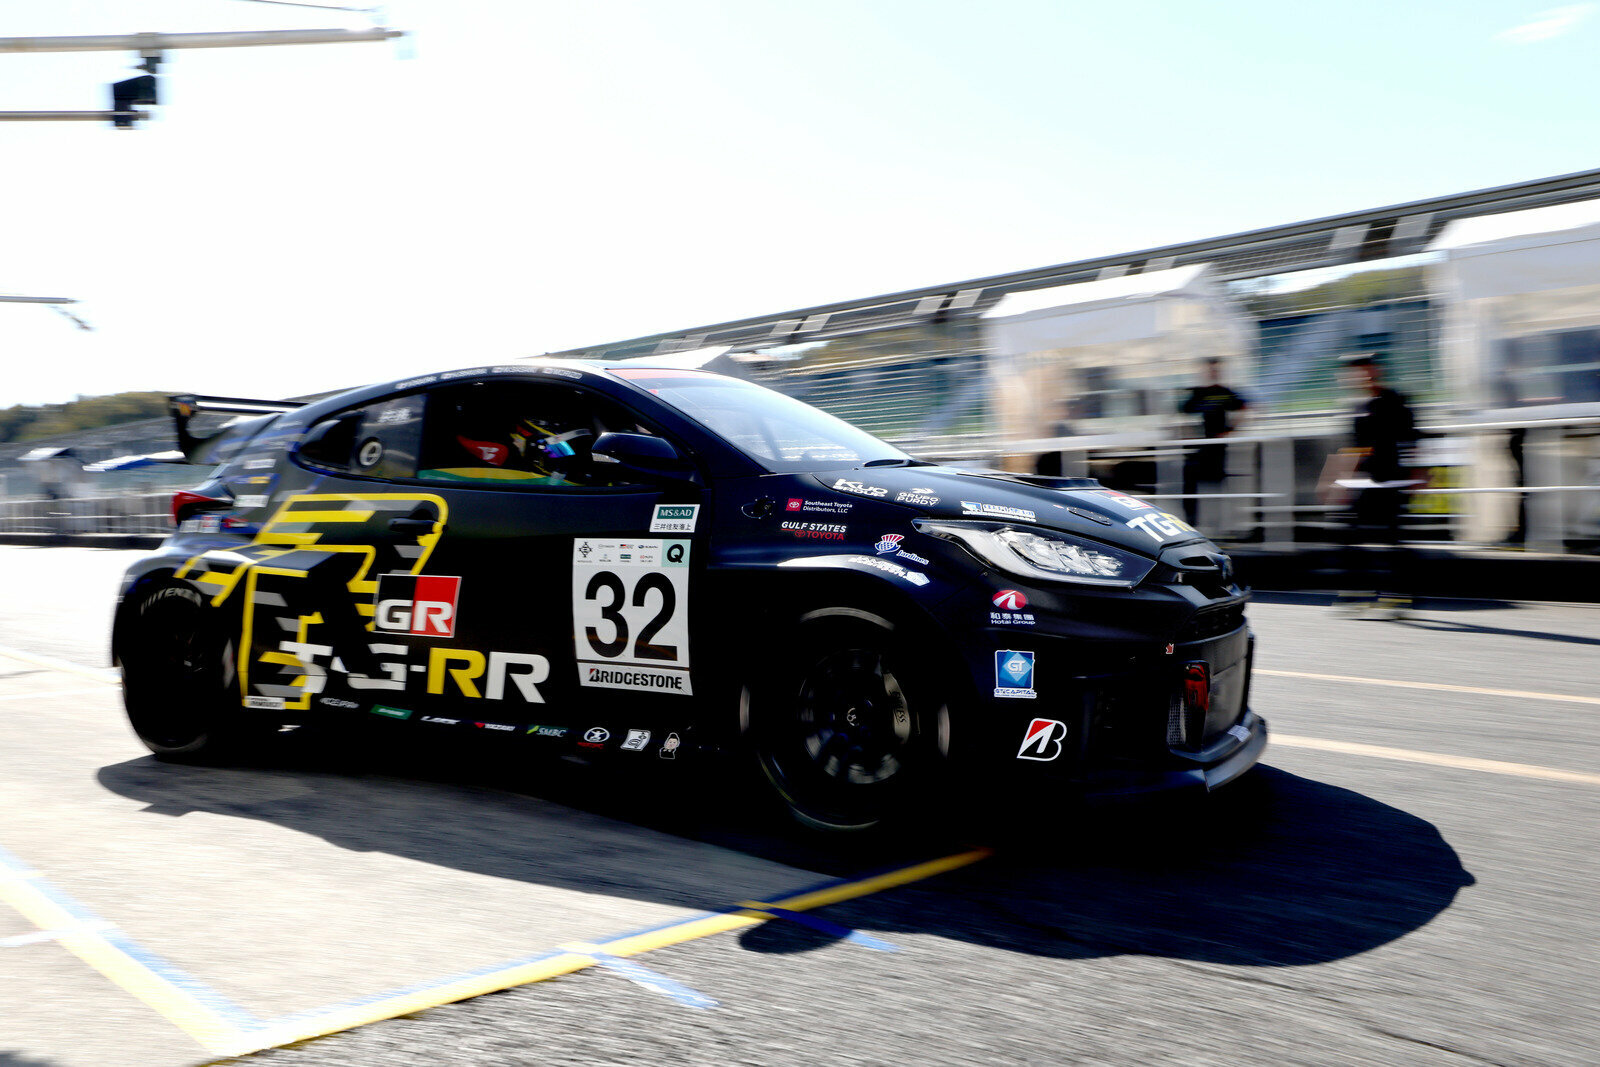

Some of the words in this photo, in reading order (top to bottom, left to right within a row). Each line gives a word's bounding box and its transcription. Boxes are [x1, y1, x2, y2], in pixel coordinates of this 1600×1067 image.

[660, 509, 693, 517] MS&AD
[781, 521, 809, 530] GULF
[809, 523, 847, 533] STATES
[806, 530, 845, 540] TOYOTA
[667, 544, 684, 563] Q
[896, 550, 929, 565] Jardines
[375, 599, 453, 633] GR
[585, 571, 678, 661] 32
[1008, 660, 1026, 671] GT
[589, 668, 683, 690] BRIDGESTONE
